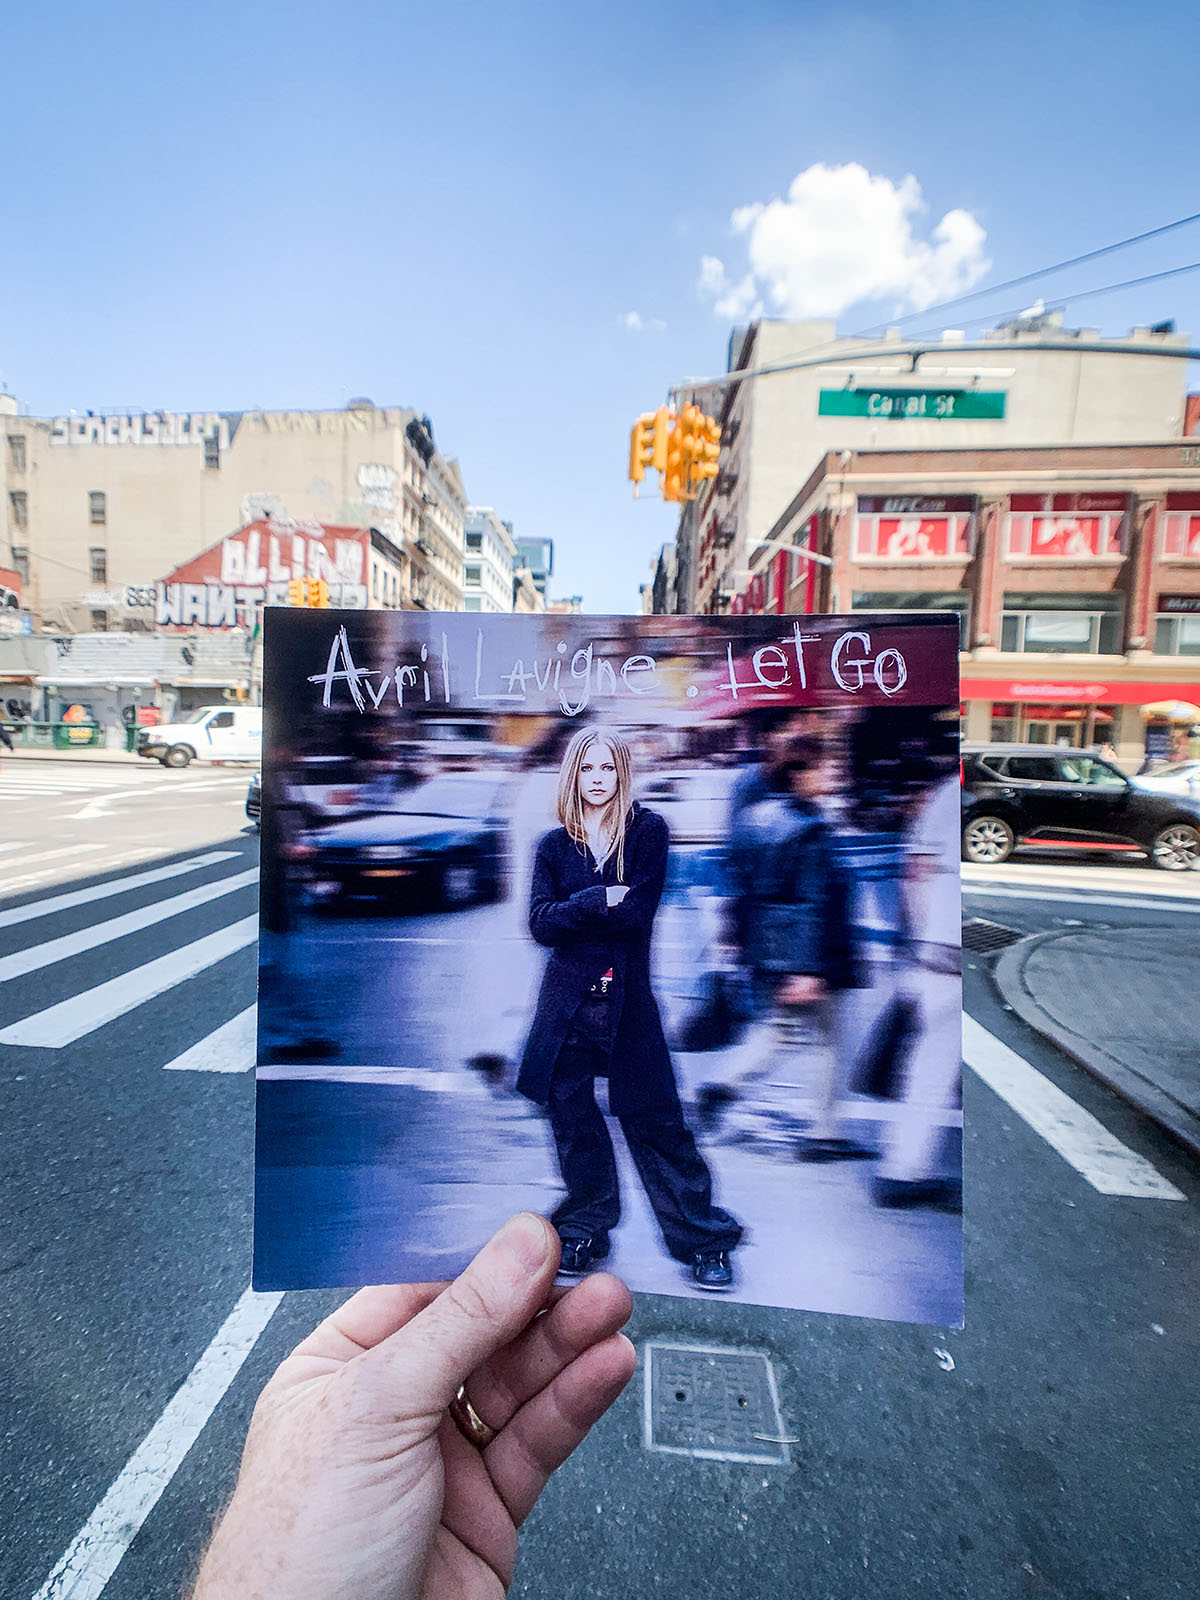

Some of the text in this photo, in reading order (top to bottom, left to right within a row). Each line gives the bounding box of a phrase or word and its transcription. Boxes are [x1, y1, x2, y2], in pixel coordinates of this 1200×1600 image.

[868, 393, 955, 416] Canal St
[307, 624, 450, 714] Avril
[716, 621, 822, 699] Let
[831, 632, 908, 698] Go
